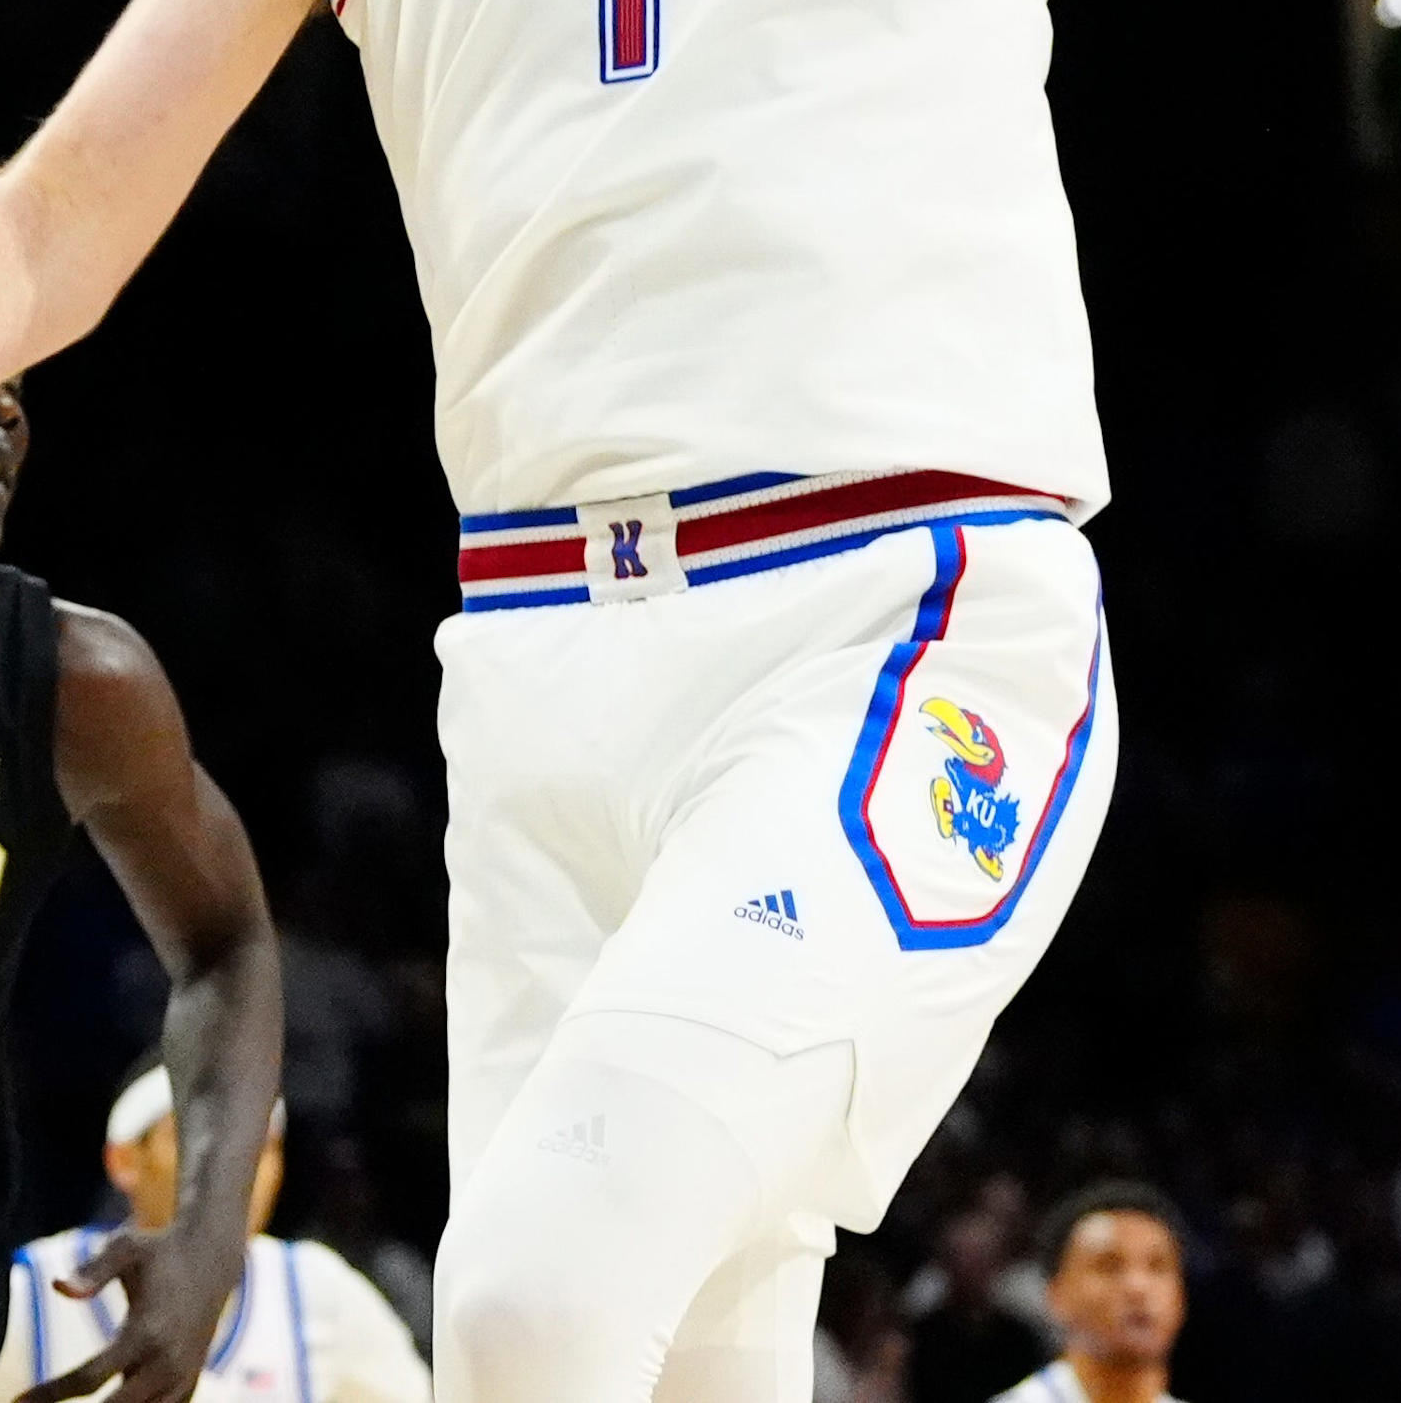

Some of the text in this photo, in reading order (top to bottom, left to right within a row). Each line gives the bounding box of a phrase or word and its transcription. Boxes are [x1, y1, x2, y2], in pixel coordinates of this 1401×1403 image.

[608, 520, 648, 580] K
[966, 789, 996, 828] KU
[733, 907, 804, 941] adidas
